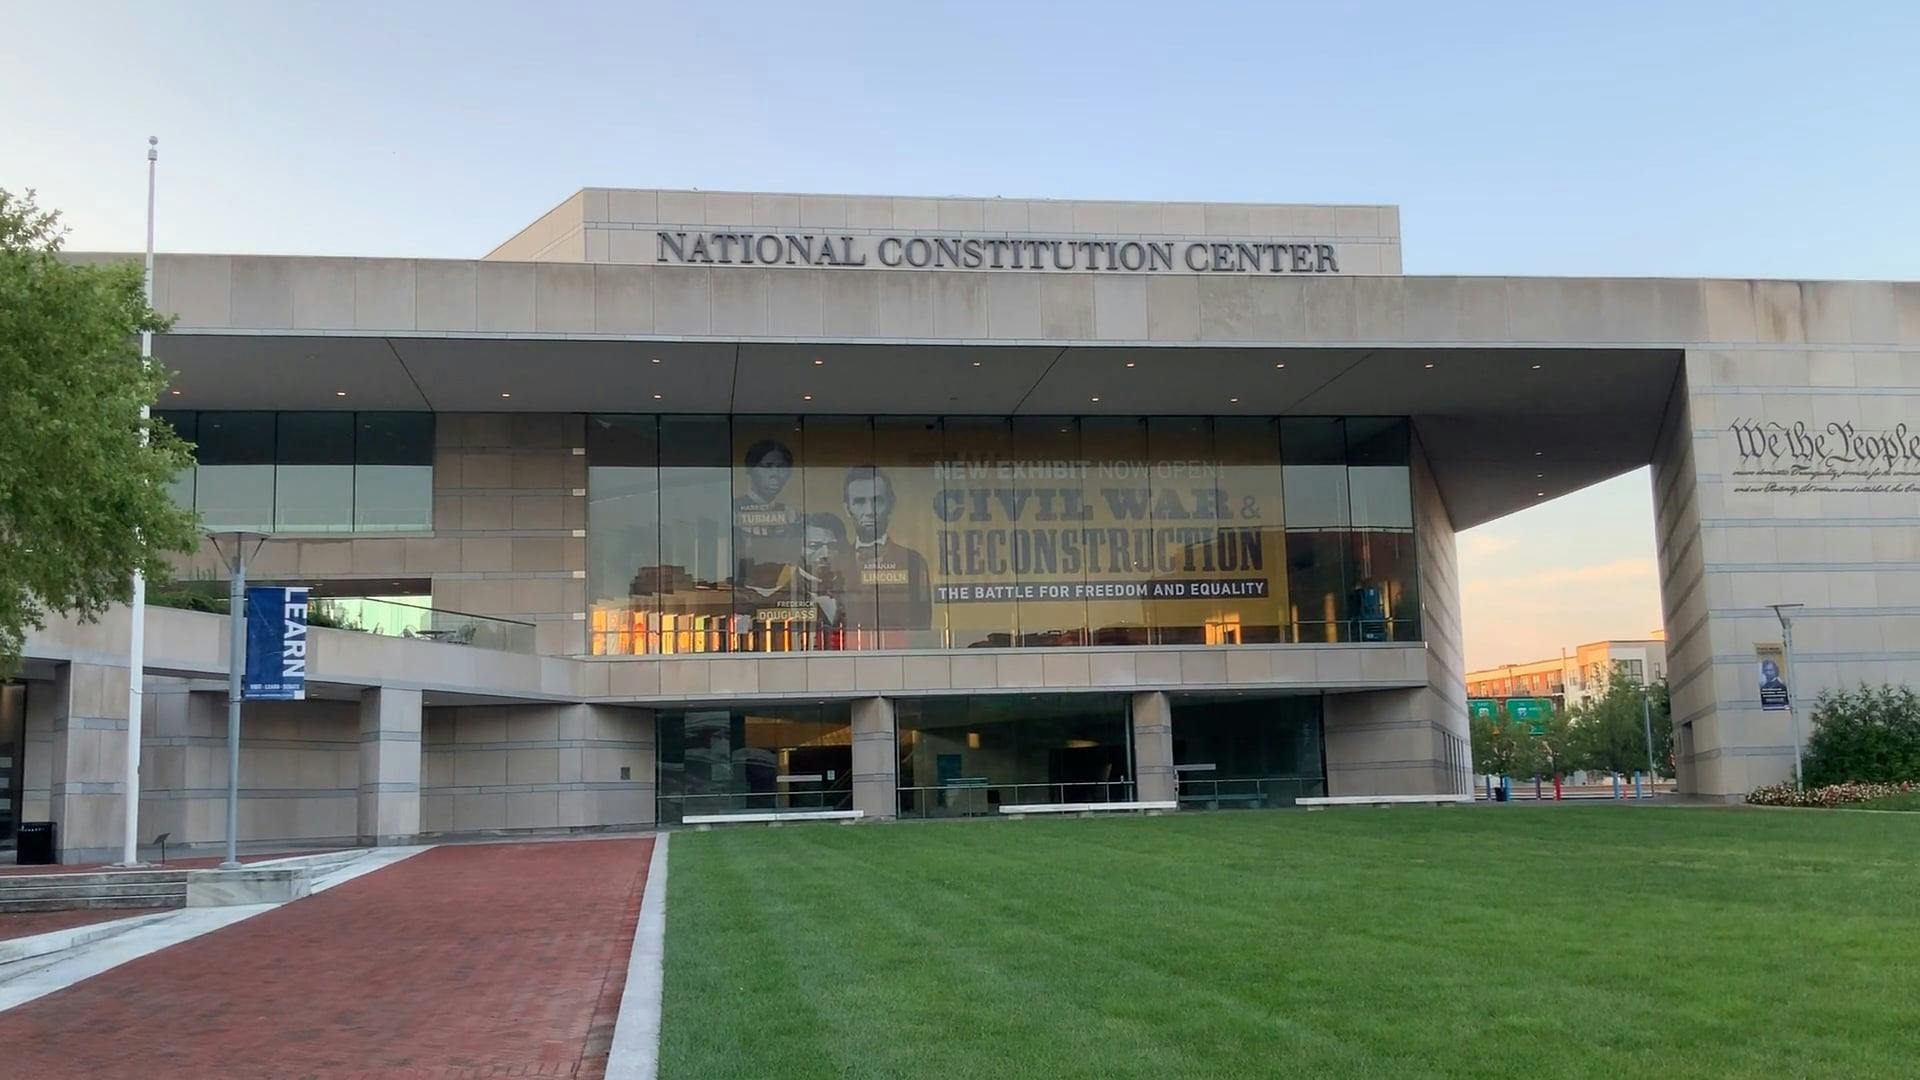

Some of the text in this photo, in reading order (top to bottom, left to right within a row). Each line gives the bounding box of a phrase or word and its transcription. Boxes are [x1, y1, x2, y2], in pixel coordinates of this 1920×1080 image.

[656, 232, 1339, 273] NATIONAL CONSTITUTION CENTER
[1728, 417, 1786, 464] We
[1784, 421, 1832, 464] the
[934, 460, 1225, 480] NEW EXHIBIT NOW OPEN!
[742, 512, 785, 524] TUBMAN
[933, 487, 1262, 522] CIVIL WAR &
[936, 526, 1264, 576] RECONSTRUCTION
[863, 572, 907, 582] LINCOLN
[938, 582, 1265, 600] THE BATTLE FOR FREEDOM AND EQUALITY
[759, 610, 815, 621] DOUGLASS
[282, 586, 309, 677] LEARN
